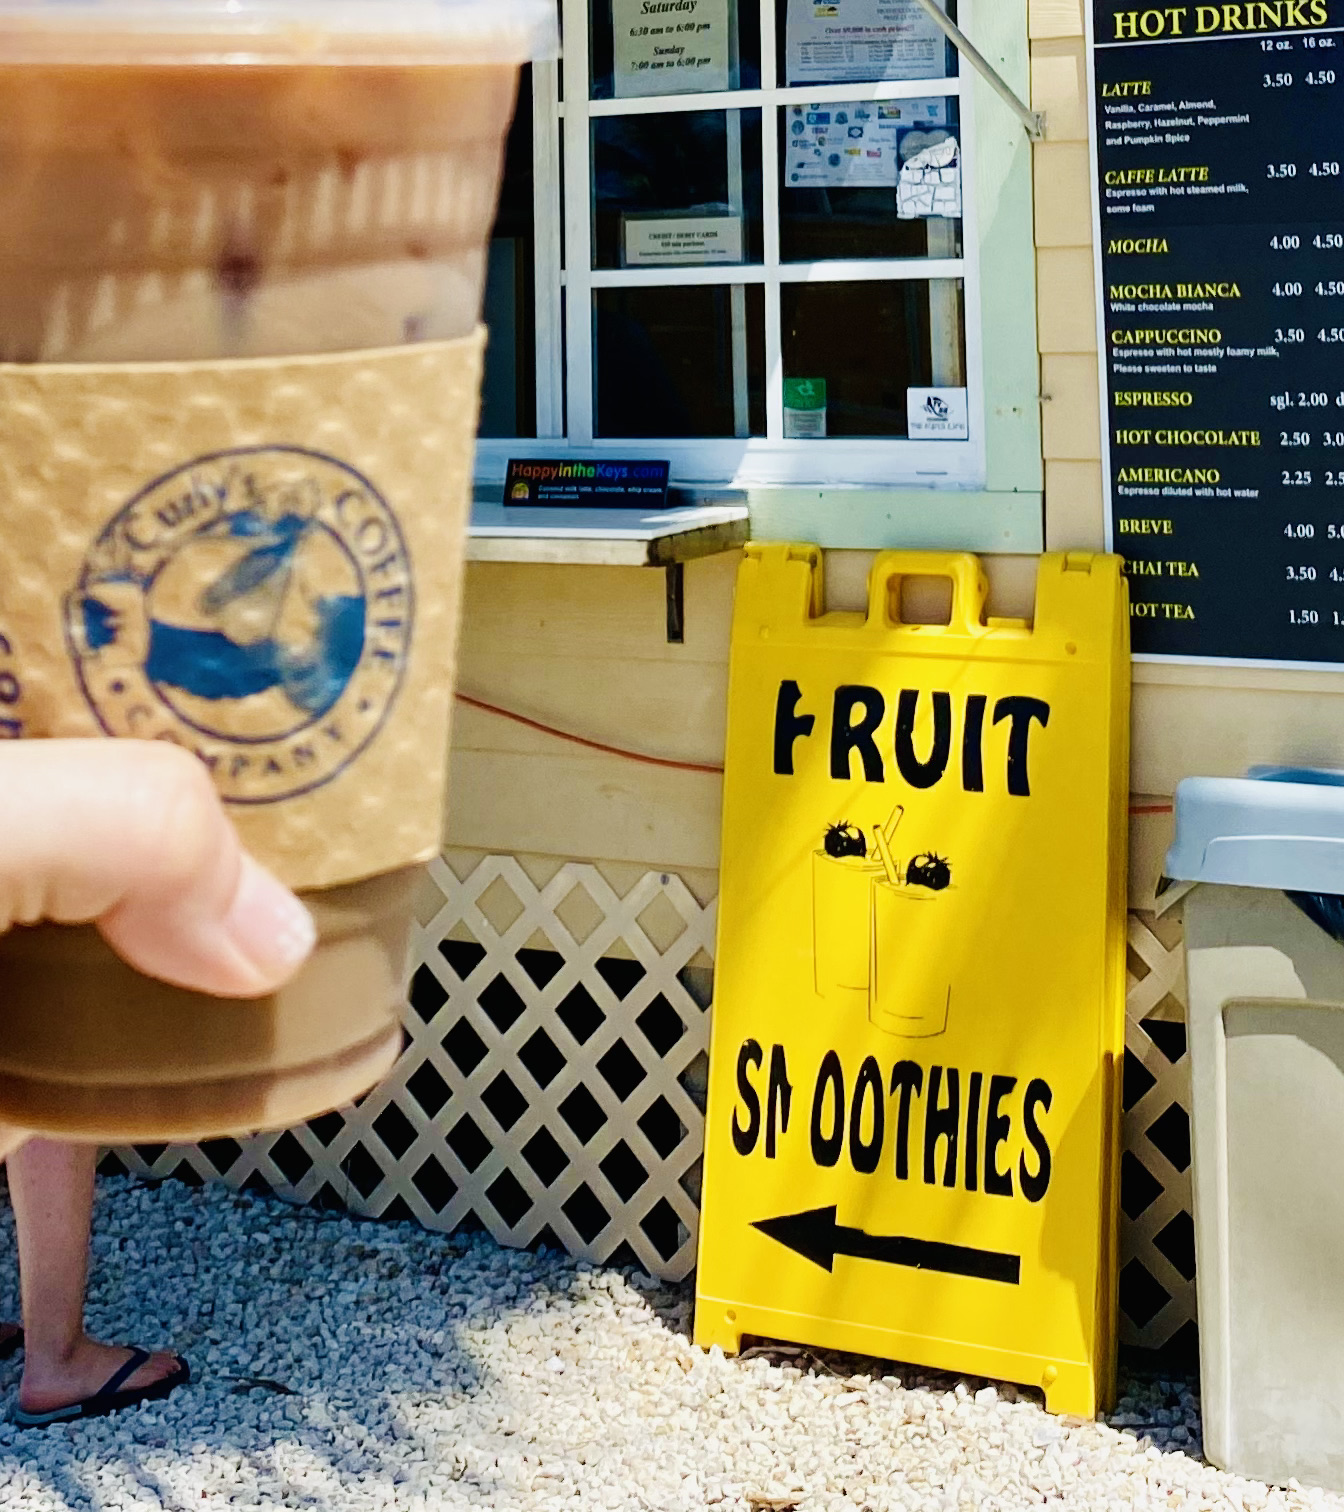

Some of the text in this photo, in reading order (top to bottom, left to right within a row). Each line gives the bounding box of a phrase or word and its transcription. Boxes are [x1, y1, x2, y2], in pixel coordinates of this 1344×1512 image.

[1113, 7, 1187, 39] HOT
[653, 44, 685, 57] Sunday
[1102, 80, 1152, 97] LATTE
[1263, 73, 1293, 88] 3.50
[1305, 70, 1336, 85] 4.50
[1105, 166, 1209, 185] CAFFE LATTE
[1108, 238, 1170, 254] MOCHA
[1270, 235, 1300, 250] 4.00
[1312, 234, 1344, 249] 4.50
[1110, 282, 1241, 299] MOCHA BIANCA
[1111, 329, 1222, 345] CAPPUCCINO
[1274, 329, 1305, 343] 3.50
[1114, 391, 1193, 407] ESPRESSO
[1270, 392, 1294, 411] sgl.
[1298, 392, 1328, 407] 2.00
[1115, 430, 1152, 445] HOT
[1154, 430, 1261, 446] CHOCOLATE
[1280, 432, 1310, 447] 2.50
[1118, 468, 1221, 484] AMERICANO
[1282, 471, 1312, 486] 2.25
[1119, 519, 1173, 535] BREVE
[1165, 561, 1199, 578] TEA
[1286, 566, 1317, 581] 3.50
[1162, 603, 1196, 620] TEA
